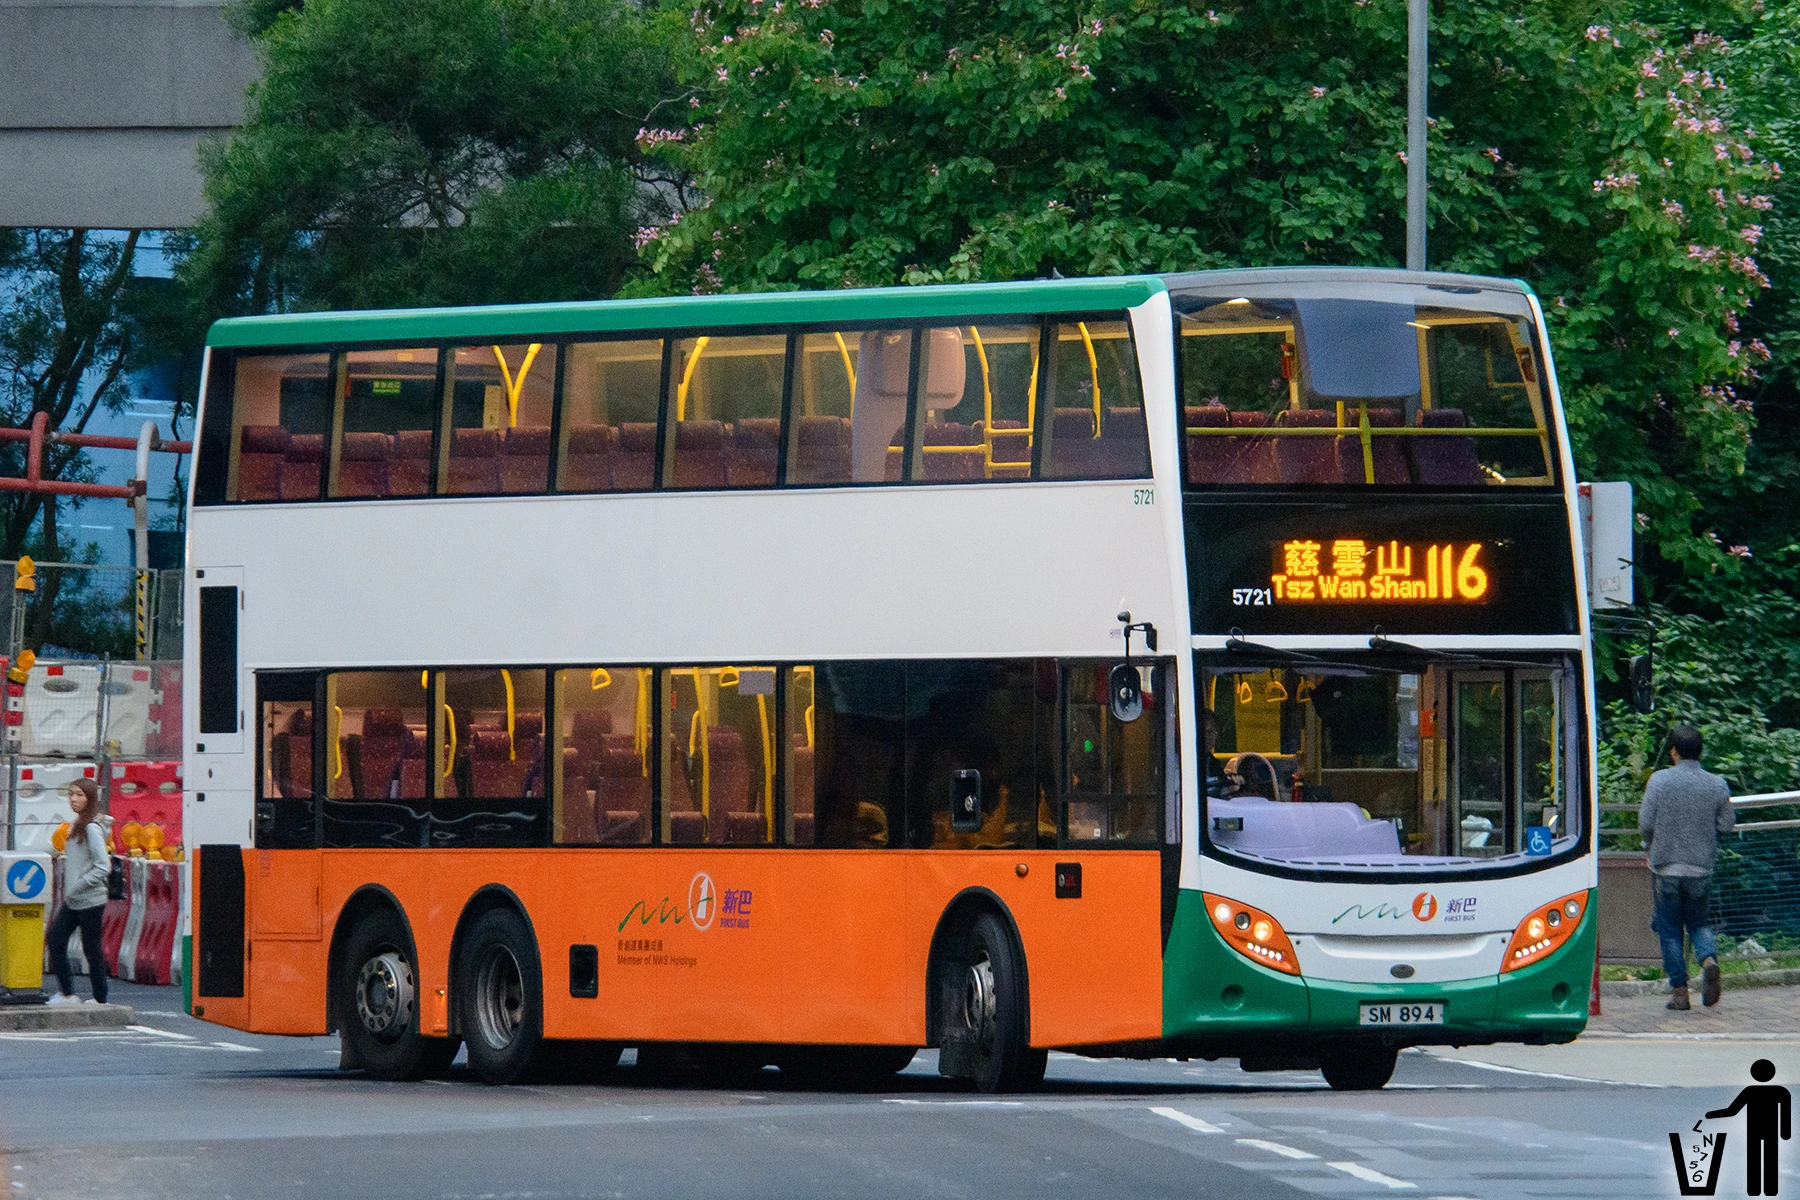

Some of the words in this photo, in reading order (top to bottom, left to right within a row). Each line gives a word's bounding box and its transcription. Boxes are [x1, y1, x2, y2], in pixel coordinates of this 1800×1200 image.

[1133, 489, 1154, 505] 5721
[1284, 540, 1411, 576] 慈雲山
[1427, 544, 1488, 599] 116
[1271, 575, 1315, 599] Tsz
[1318, 575, 1367, 599] Wan
[1370, 575, 1427, 599] Shan
[1232, 588, 1272, 605] 5721
[722, 888, 753, 915] 新巴
[1446, 897, 1477, 913] 新巴
[1444, 914, 1461, 922] FIRST
[1368, 1007, 1391, 1022] SM
[1400, 1006, 1434, 1022] 894
